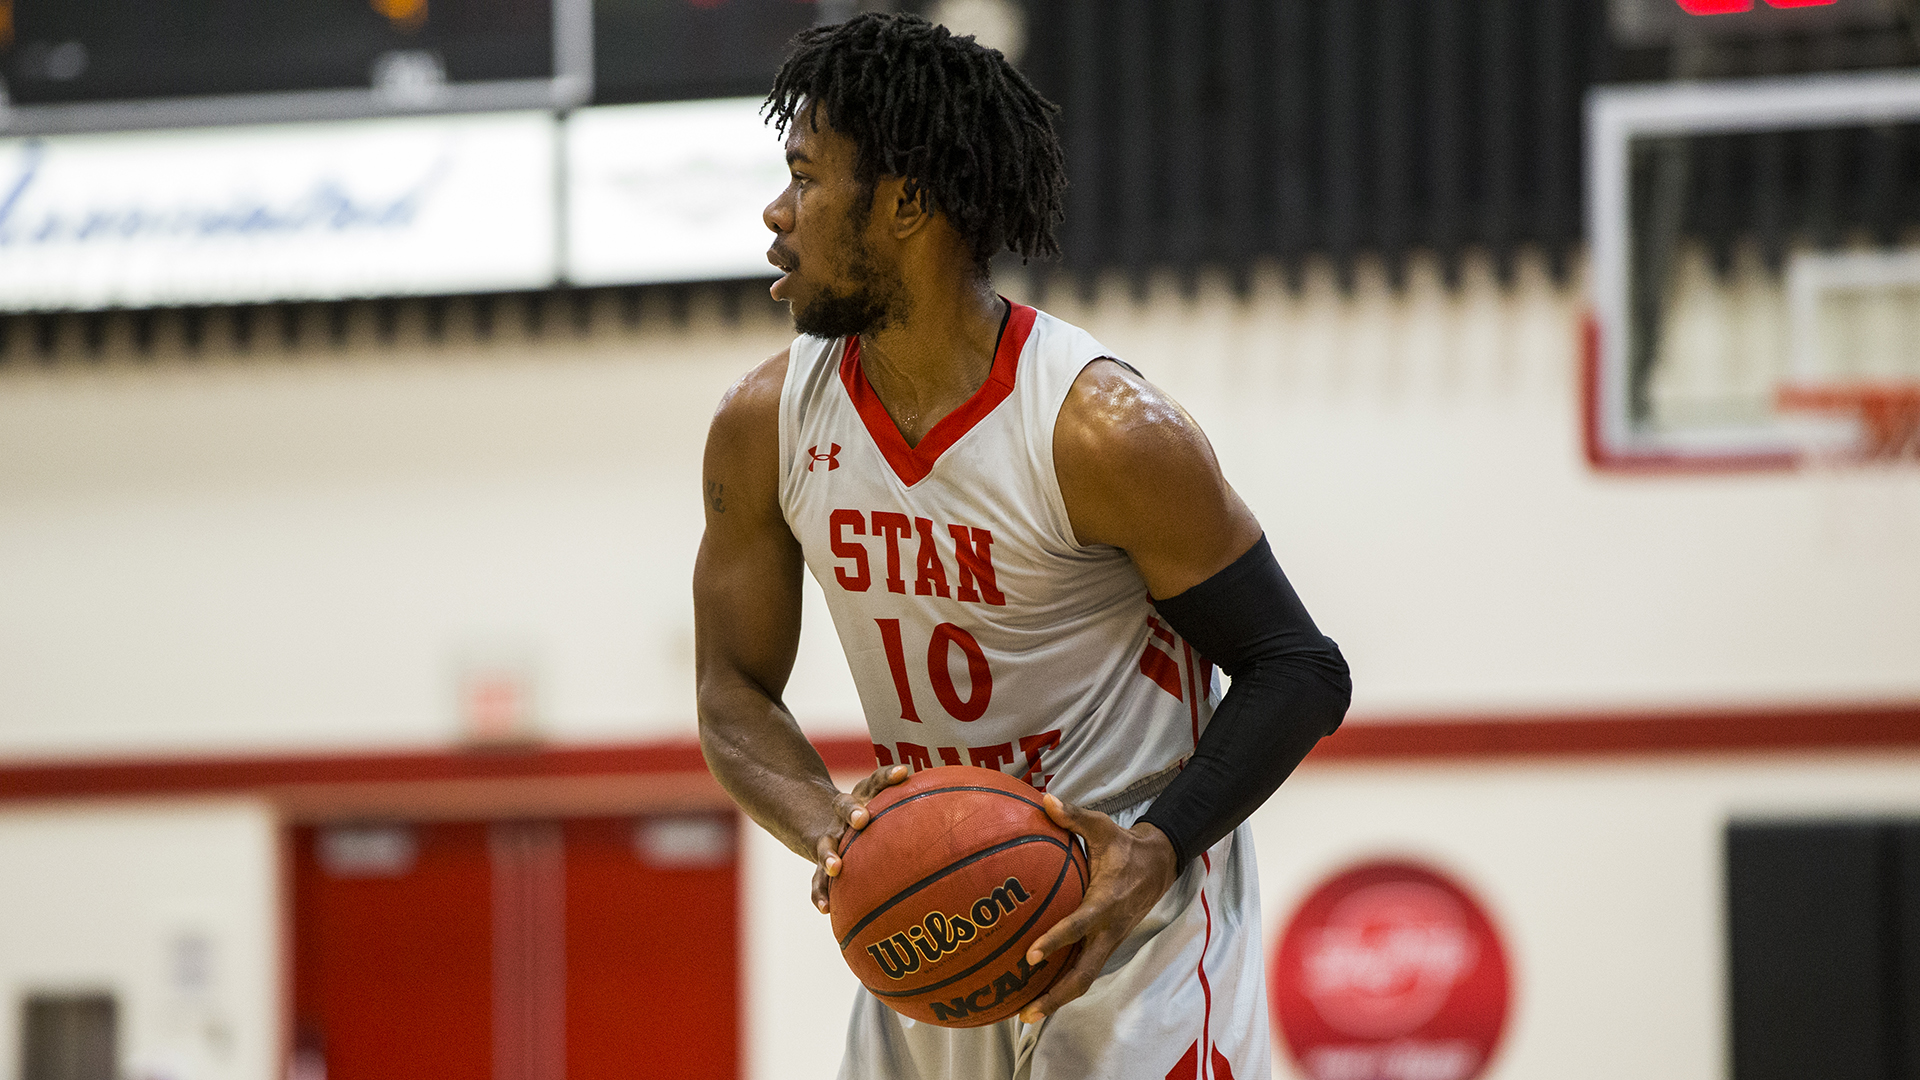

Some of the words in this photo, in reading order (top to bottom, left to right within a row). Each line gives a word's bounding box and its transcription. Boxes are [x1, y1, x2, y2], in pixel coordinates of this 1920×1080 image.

[829, 508, 1006, 606] STAN
[873, 618, 993, 724] 10
[866, 876, 1031, 980] Wilson
